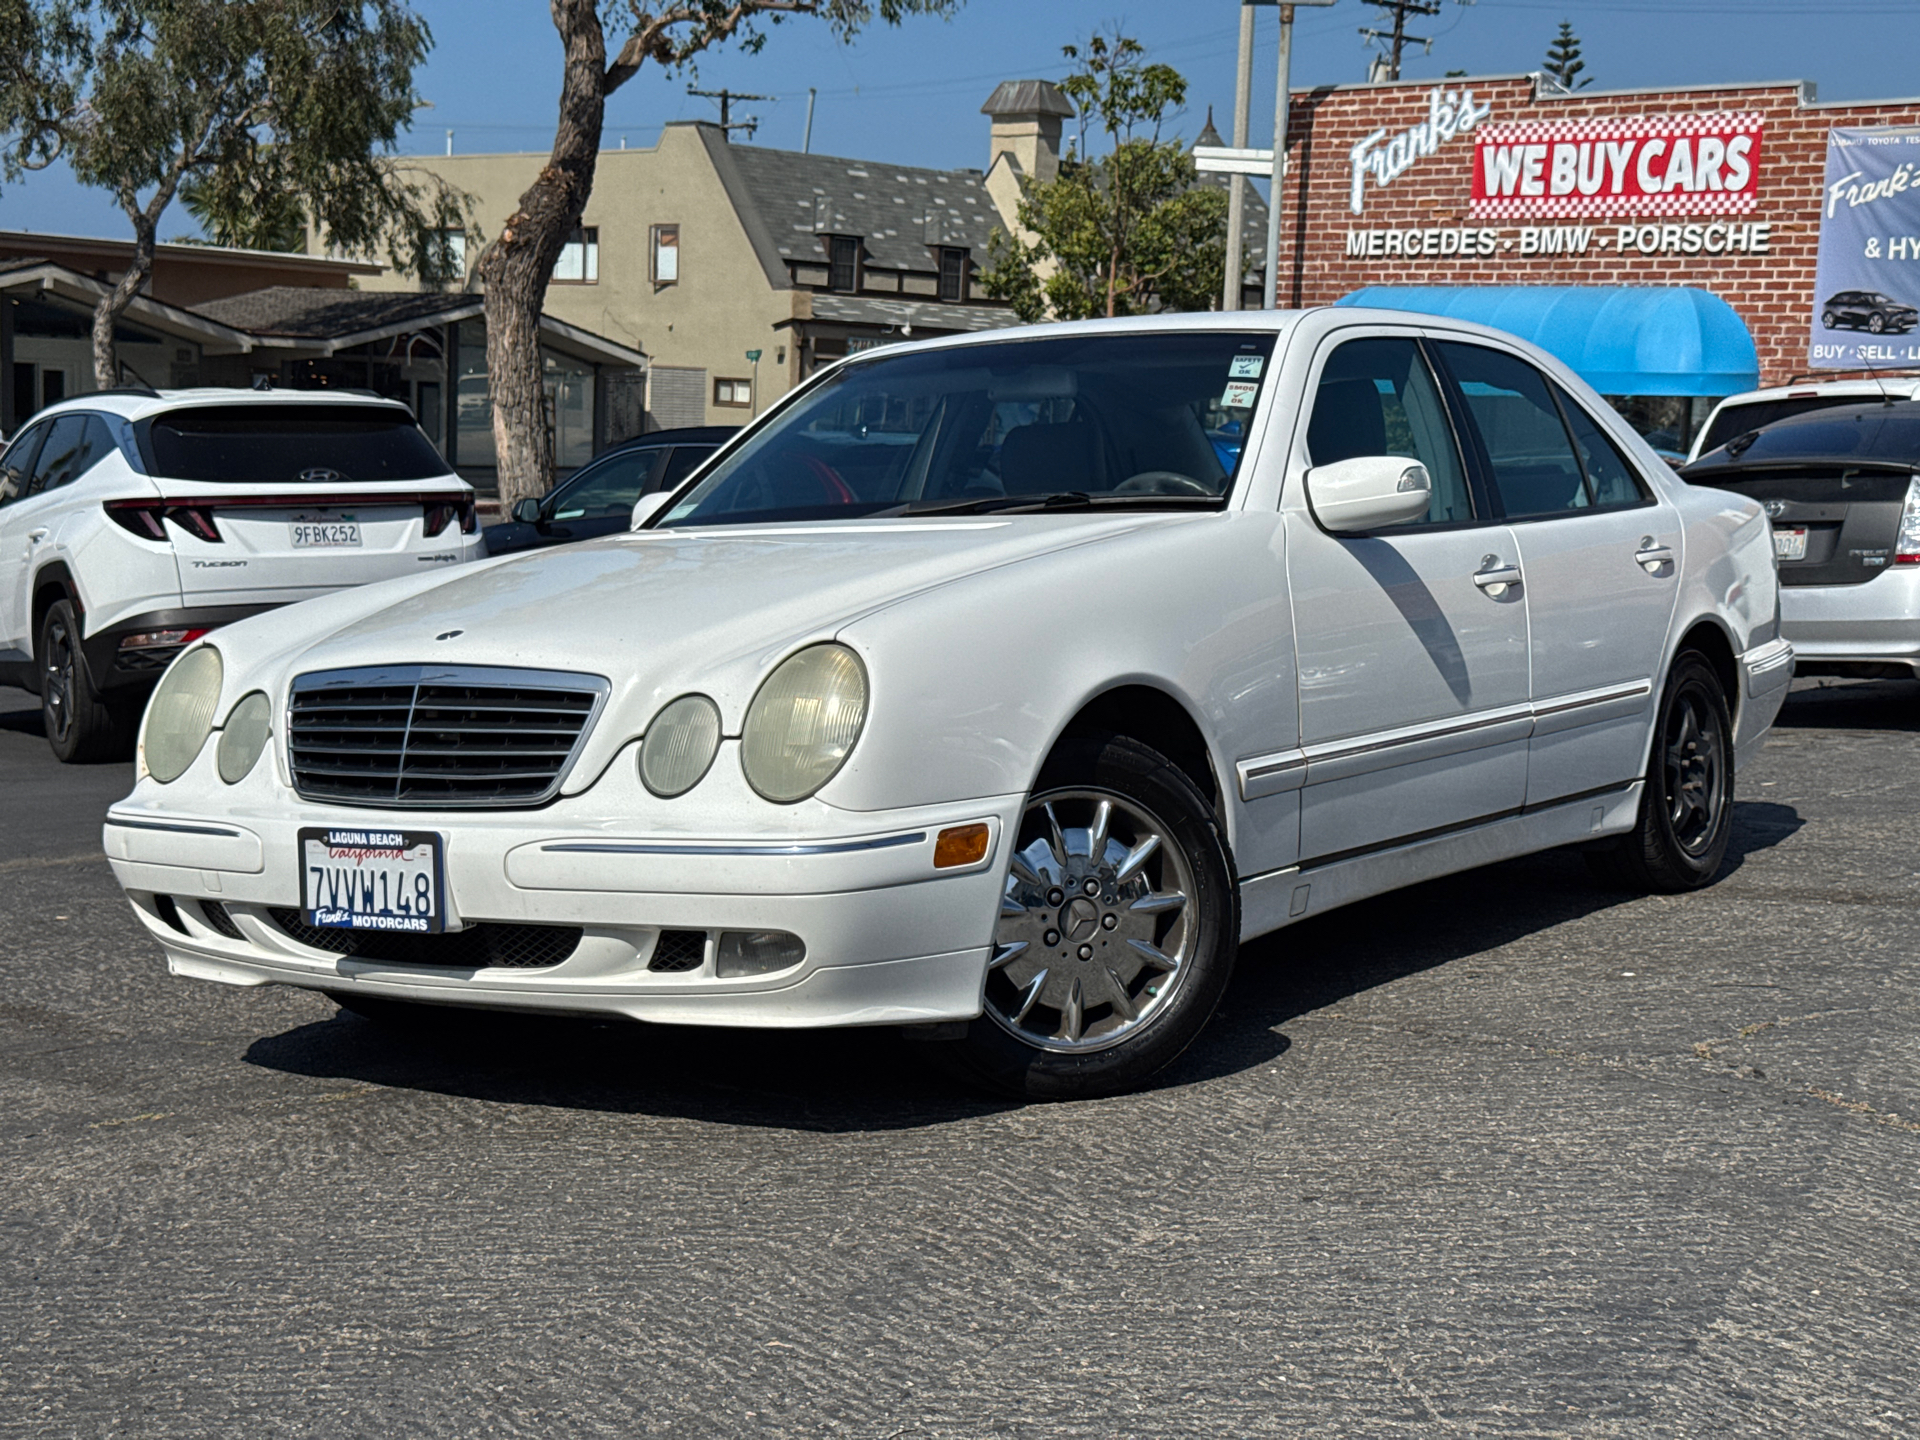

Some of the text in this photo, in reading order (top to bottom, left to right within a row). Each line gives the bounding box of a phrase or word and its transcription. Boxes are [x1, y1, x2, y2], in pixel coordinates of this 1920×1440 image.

[1867, 137, 1900, 146] TOYOTA
[1905, 135, 1920, 145] TES
[1350, 87, 1490, 215] Frank's
[1482, 134, 1754, 197] WE BUY CARS
[1346, 224, 1771, 257] MERCEDES BMW PORSCHE
[1864, 237, 1880, 259] &
[1813, 344, 1846, 359] BUY
[1856, 344, 1896, 360] SELL
[295, 525, 357, 543] 9FBK252
[329, 831, 403, 846] LAGUNA BEACH
[310, 867, 430, 916] 7VVW148
[352, 915, 428, 931] MOTORCARS
